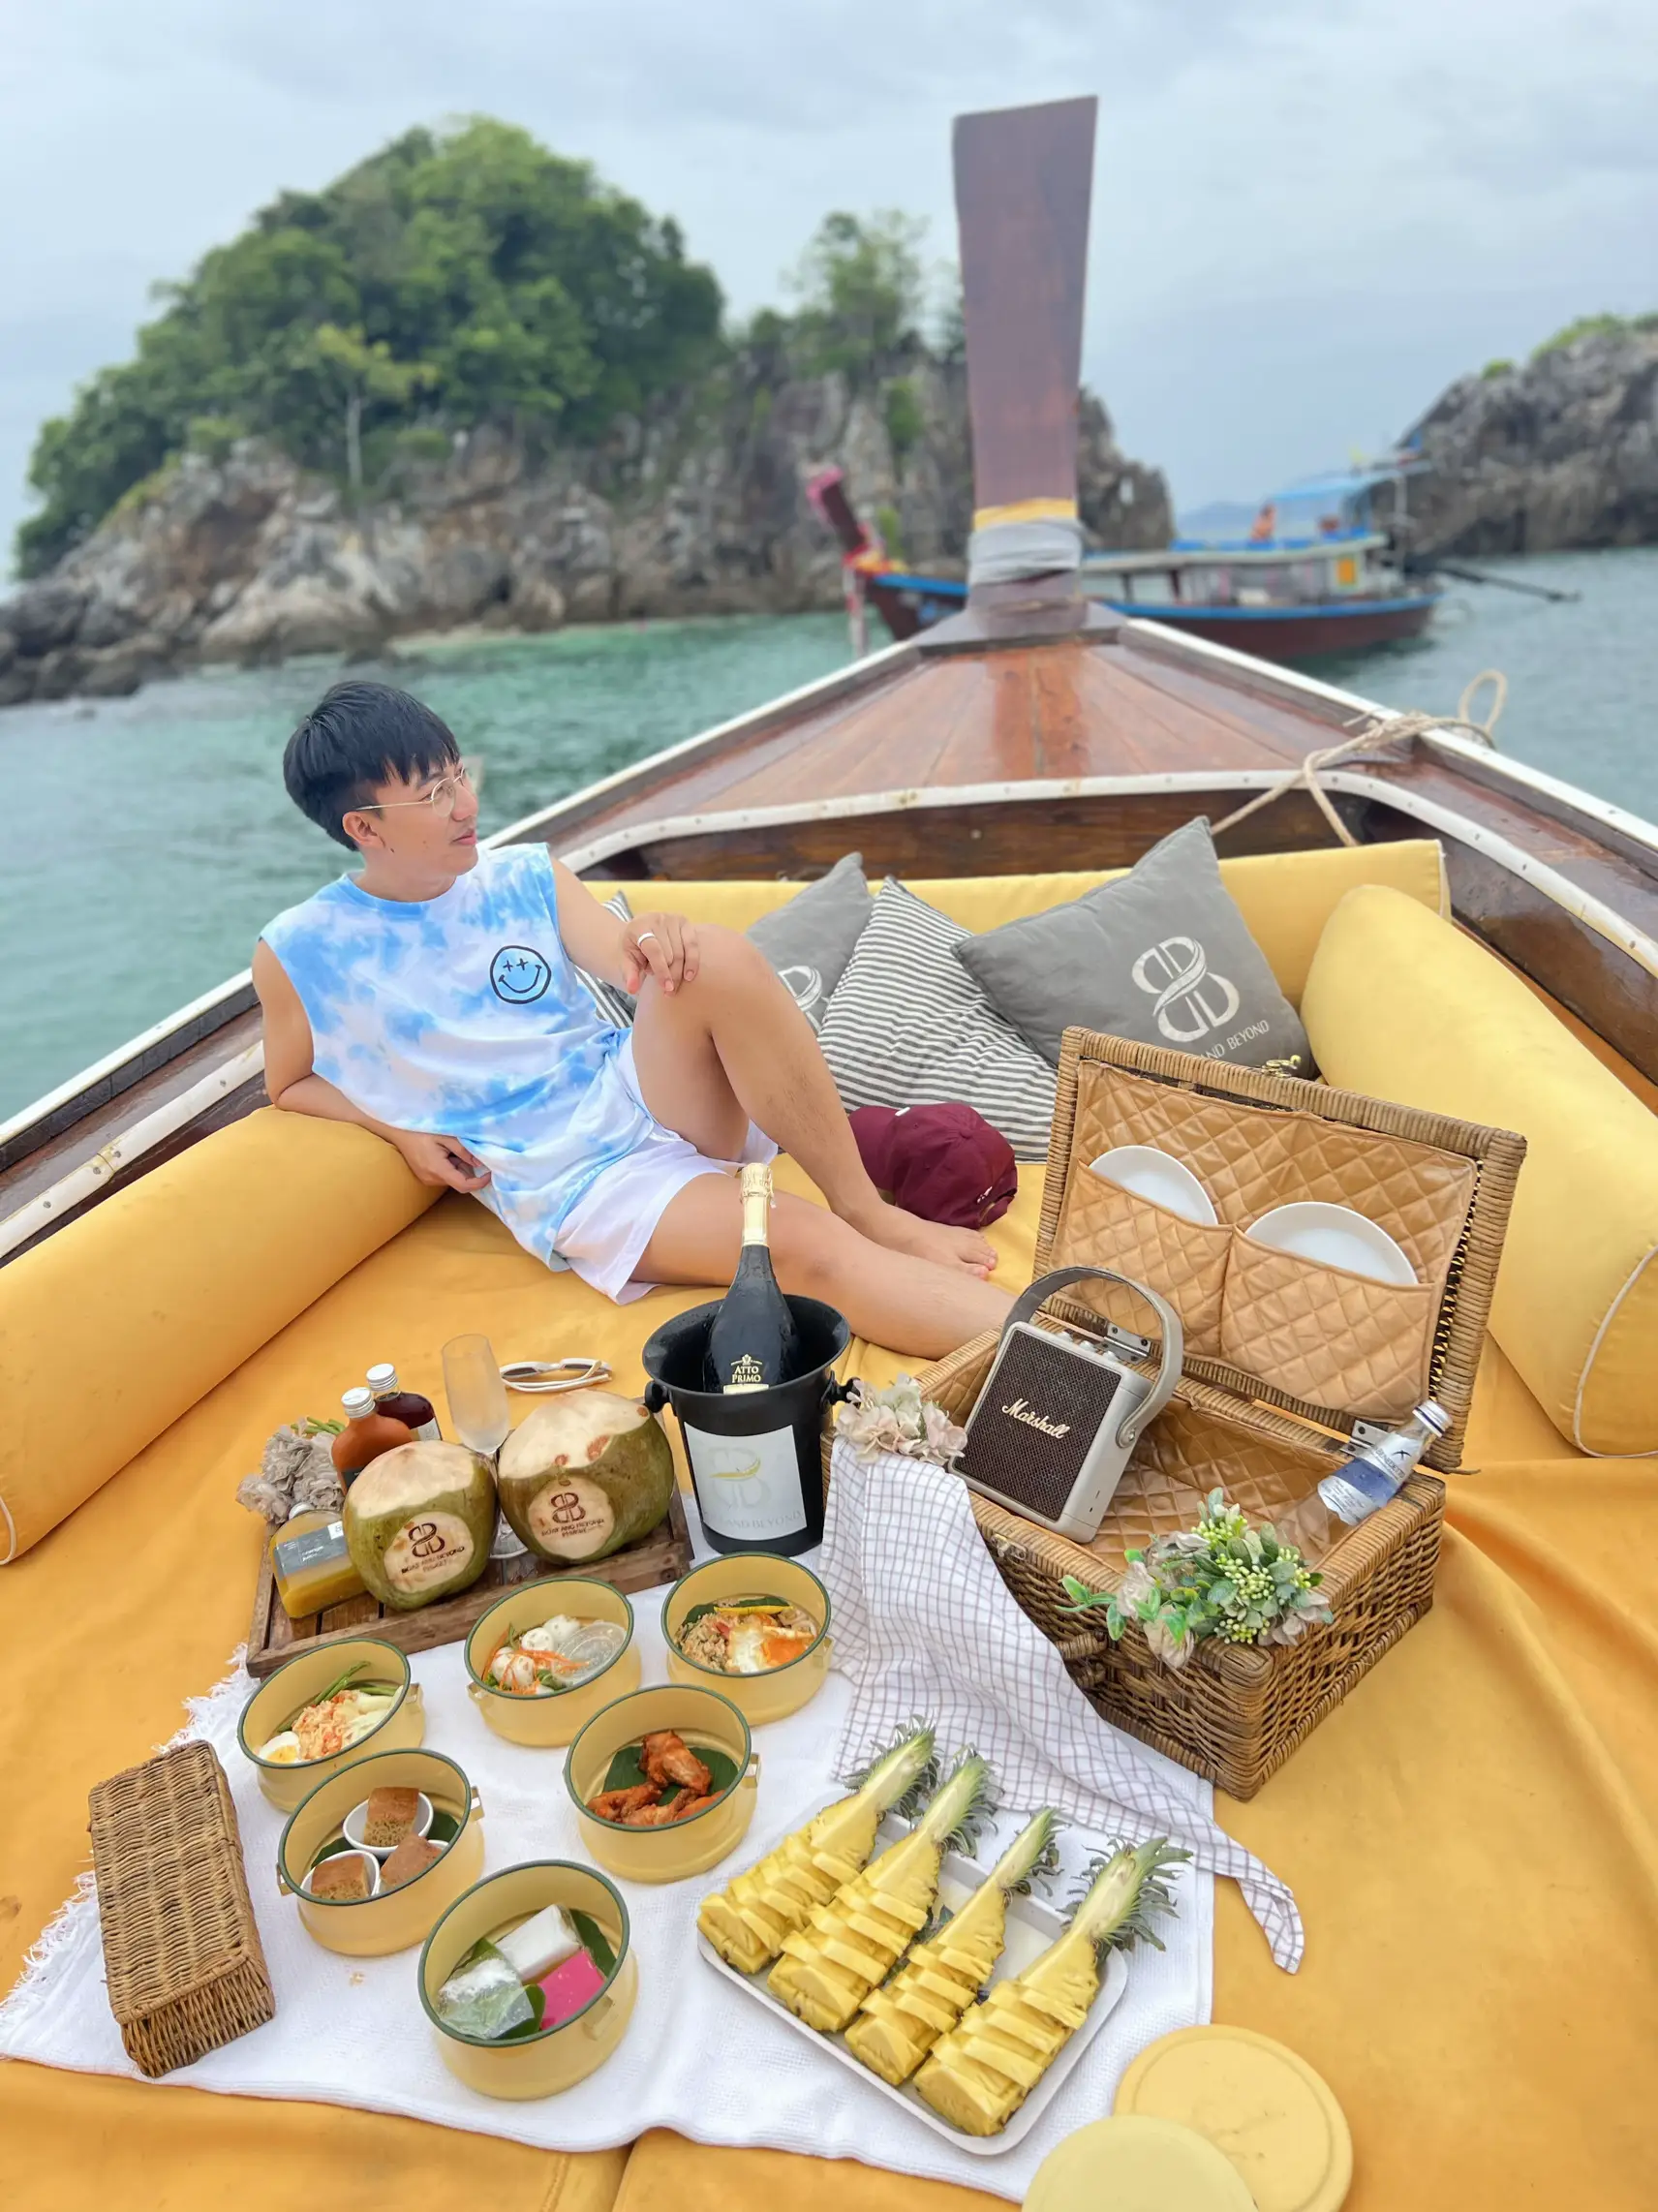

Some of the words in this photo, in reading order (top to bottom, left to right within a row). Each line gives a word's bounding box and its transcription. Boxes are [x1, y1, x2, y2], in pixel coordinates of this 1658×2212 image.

[1226, 1020, 1270, 1051] BEYOND
[732, 1374, 761, 1383] PRIMO
[734, 1366, 759, 1374] ATTO
[1001, 1398, 1070, 1439] Marshall
